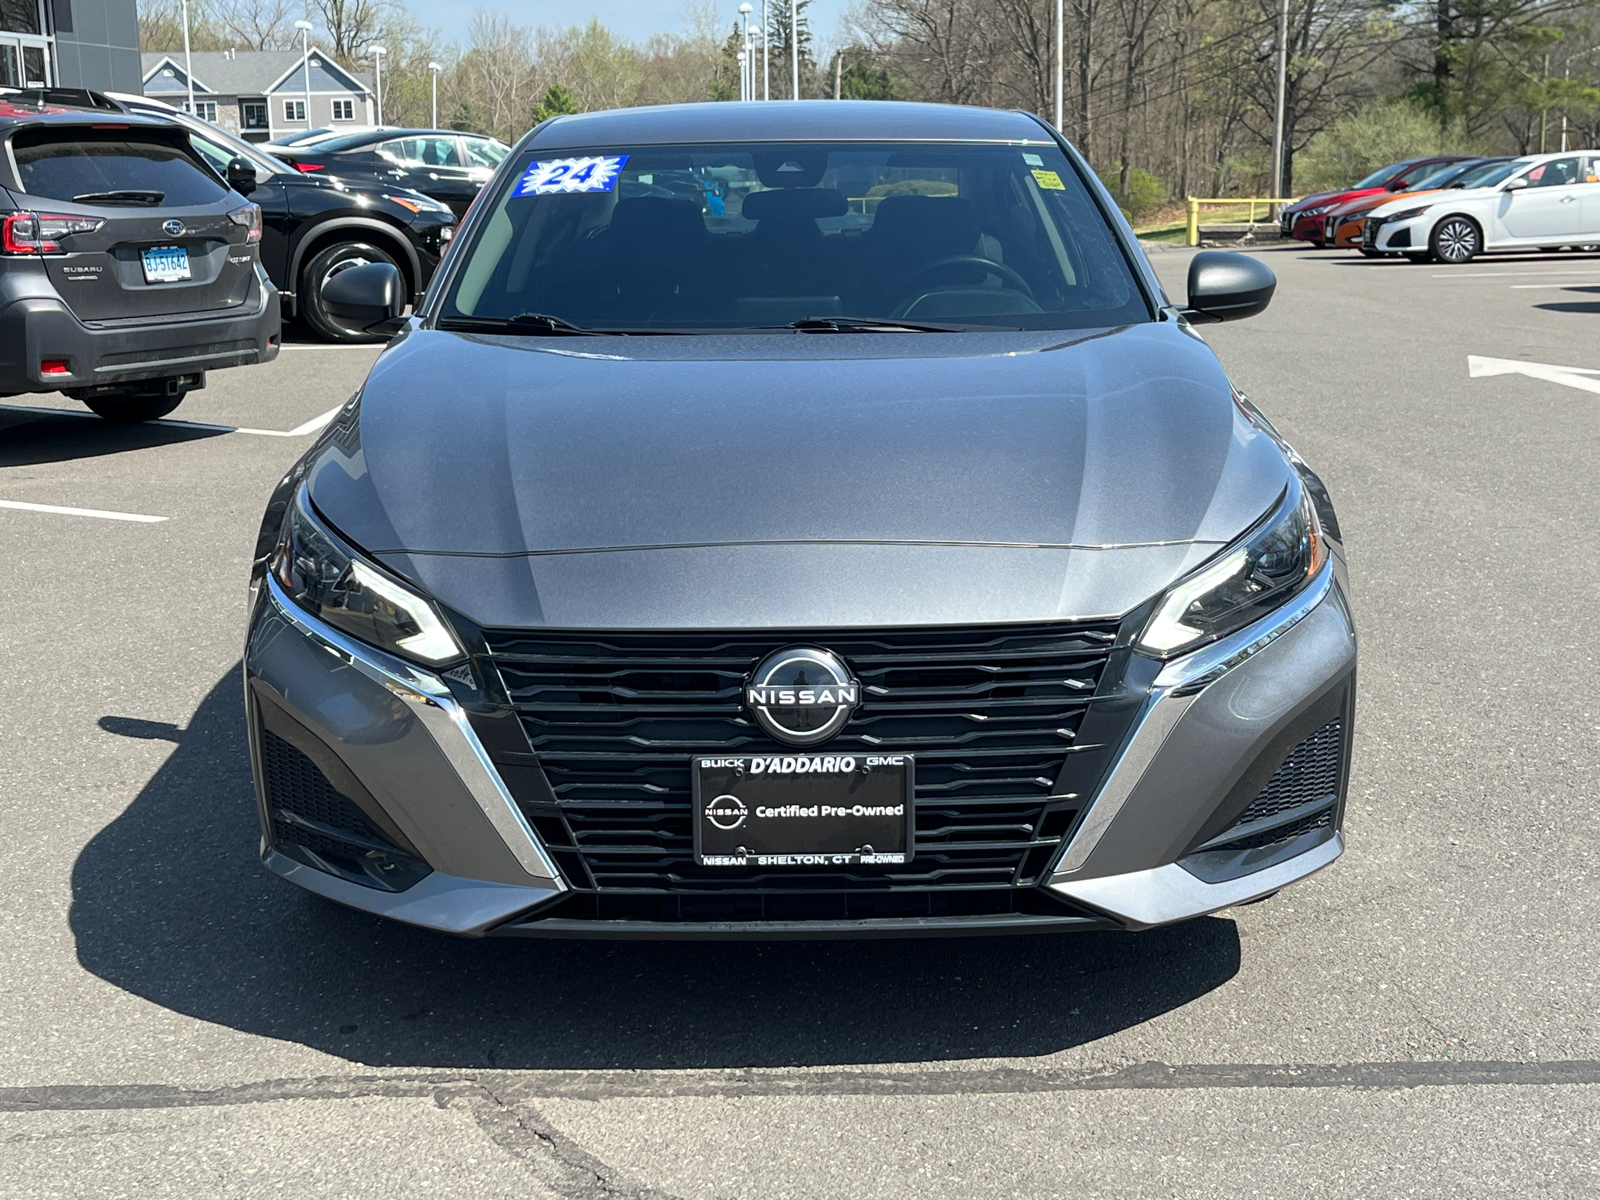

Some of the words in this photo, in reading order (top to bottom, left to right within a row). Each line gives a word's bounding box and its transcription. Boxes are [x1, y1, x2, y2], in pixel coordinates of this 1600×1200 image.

[540, 163, 597, 186] 24
[749, 688, 855, 704] NISSAN
[701, 759, 745, 768] BUICK
[750, 756, 855, 774] D'ADDARIO
[866, 756, 904, 766] GMC
[705, 808, 748, 816] NISSAN
[756, 805, 818, 818] Certified
[821, 804, 904, 817] Pre-Owned
[703, 856, 747, 866] NISSAN
[758, 855, 829, 866] SHELTON,
[832, 855, 851, 864] CT
[860, 855, 904, 864] PRE-OWNED
